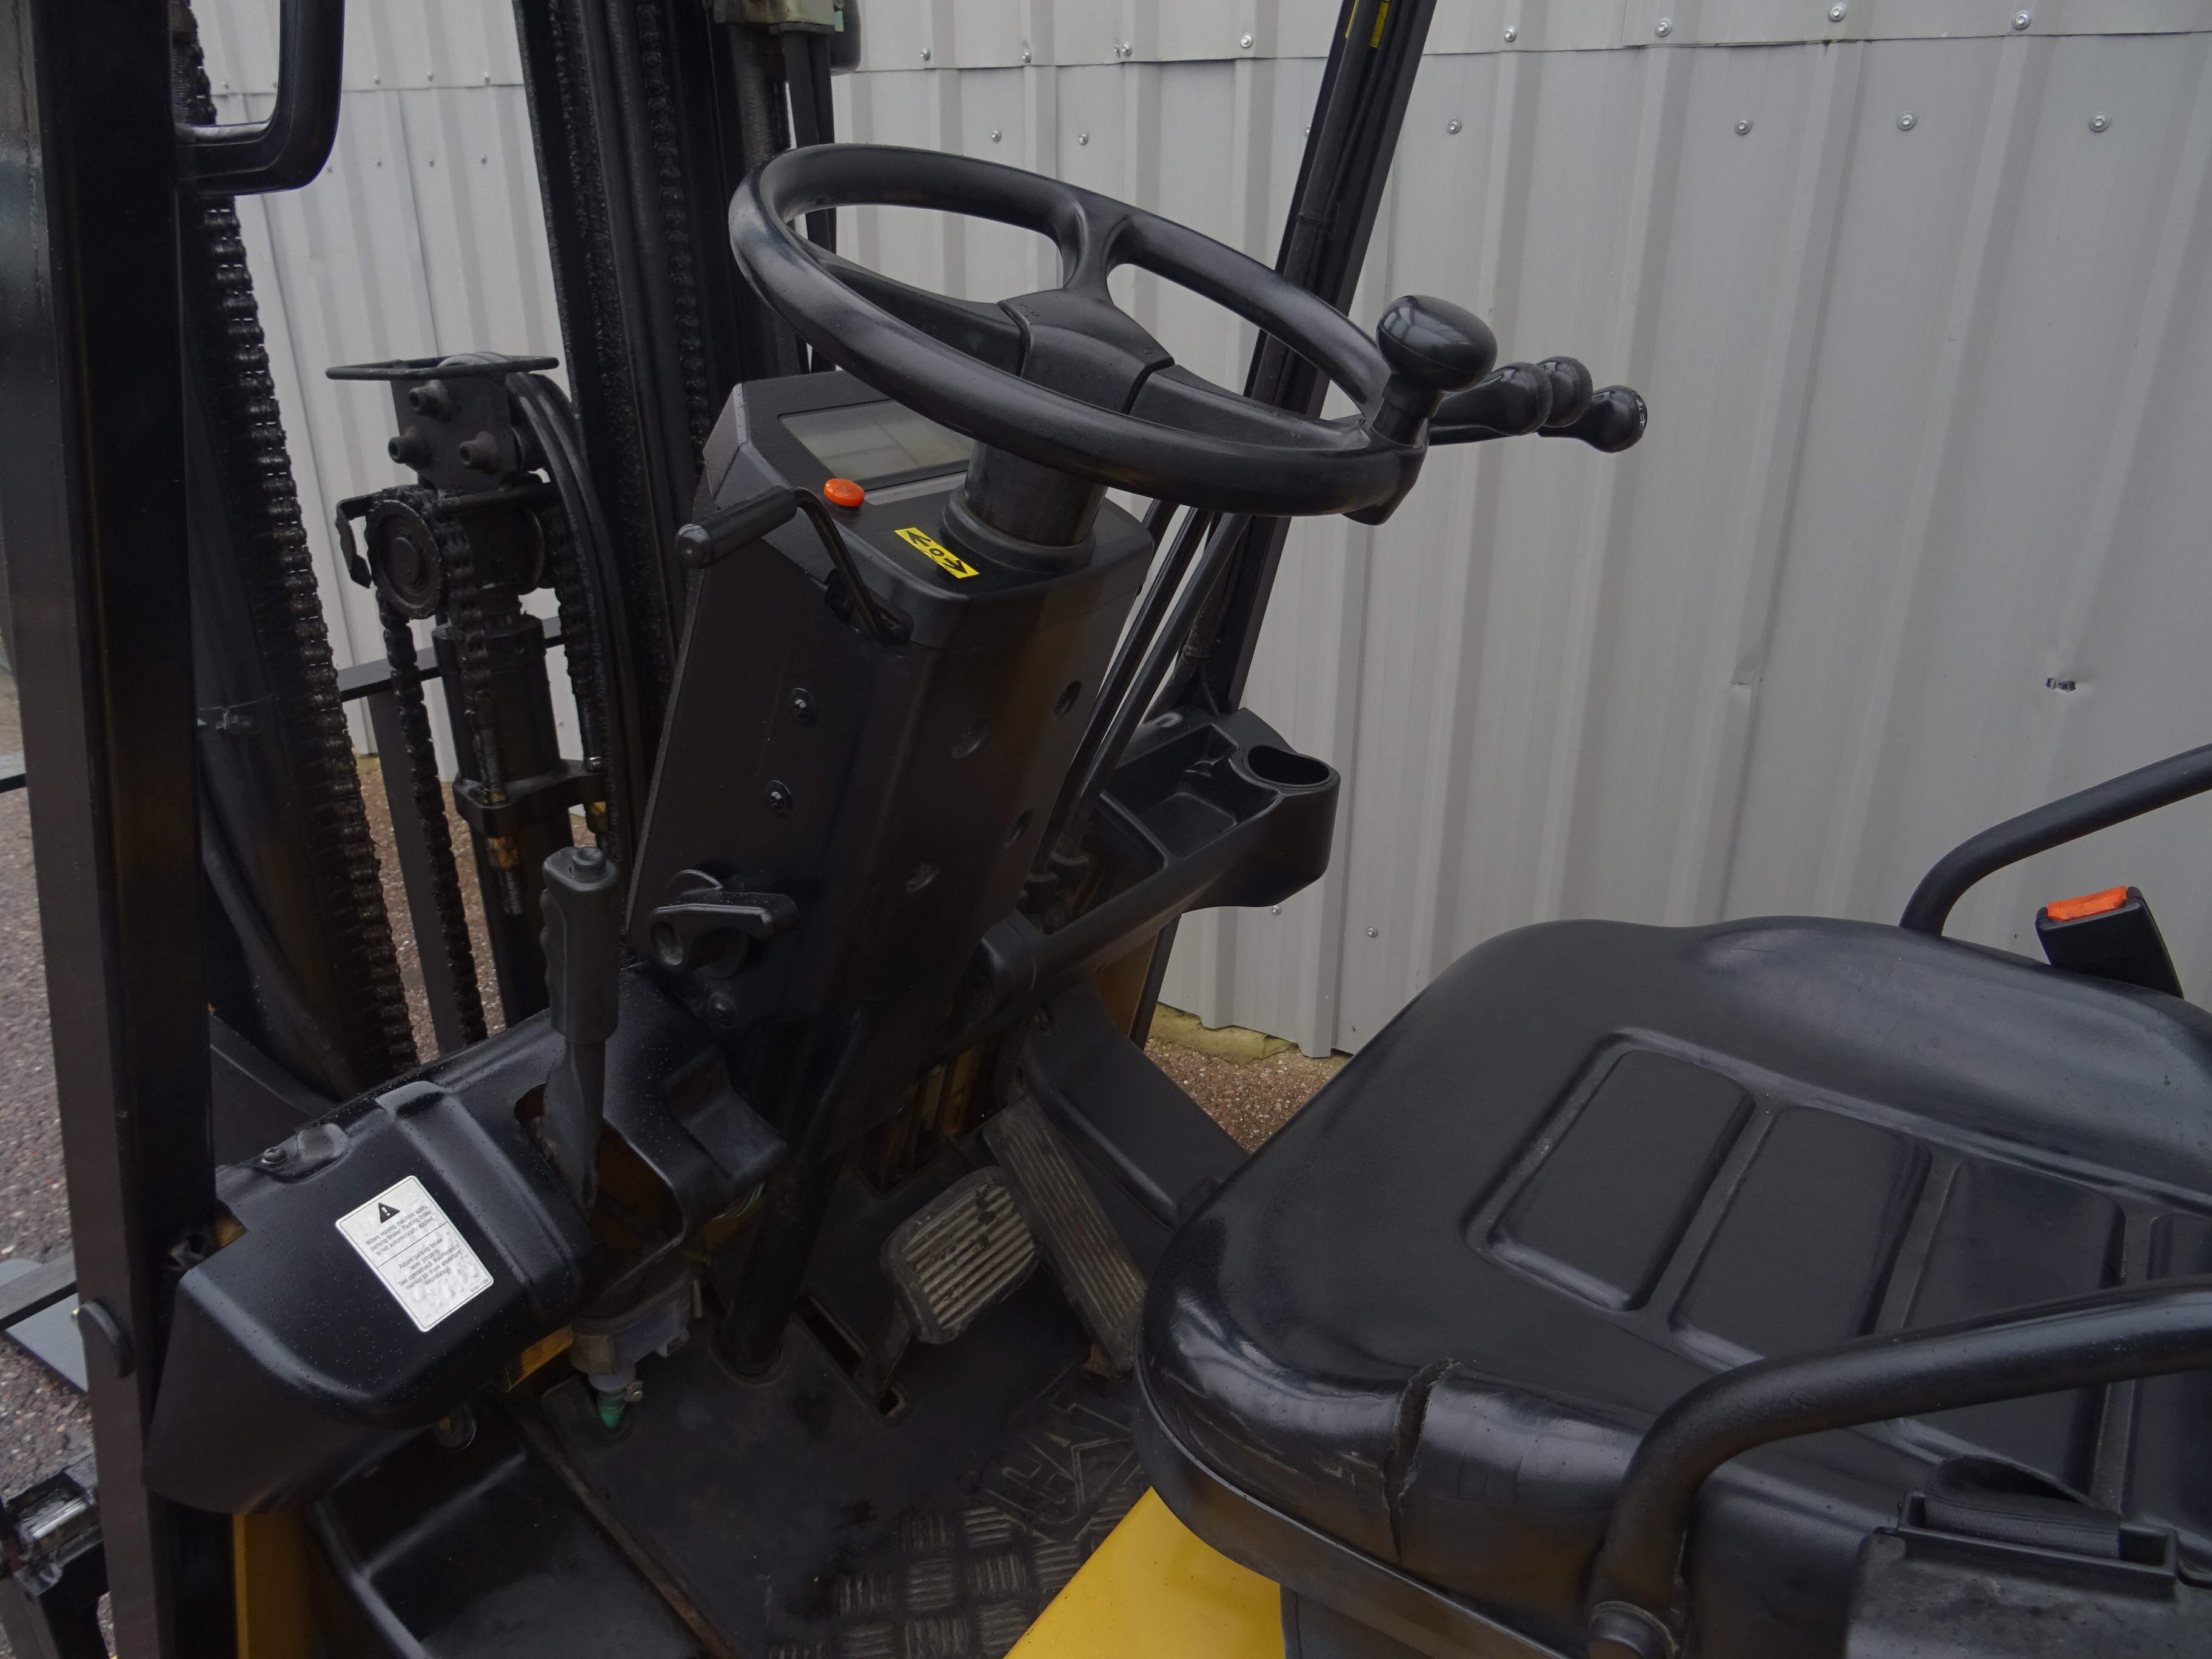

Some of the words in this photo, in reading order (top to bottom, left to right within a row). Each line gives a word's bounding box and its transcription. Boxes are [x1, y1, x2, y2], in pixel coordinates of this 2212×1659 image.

[365, 1235, 380, 1245] When
[380, 1224, 397, 1236] leaving
[396, 1212, 415, 1225] machine
[370, 1238, 388, 1252] parking
[387, 1228, 401, 1239] brake!
[401, 1218, 420, 1230] Parking
[418, 1210, 431, 1219] brake
[389, 1227, 418, 1247] automatically
[398, 1256, 414, 1269] Adjust
[413, 1246, 430, 1259] parking
[429, 1238, 442, 1248] brake
[409, 1261, 421, 1269] lever
[433, 1243, 459, 1262] maintenance
[406, 1278, 422, 1290] manual
[429, 1264, 441, 1274] more
[441, 1250, 461, 1265] important
